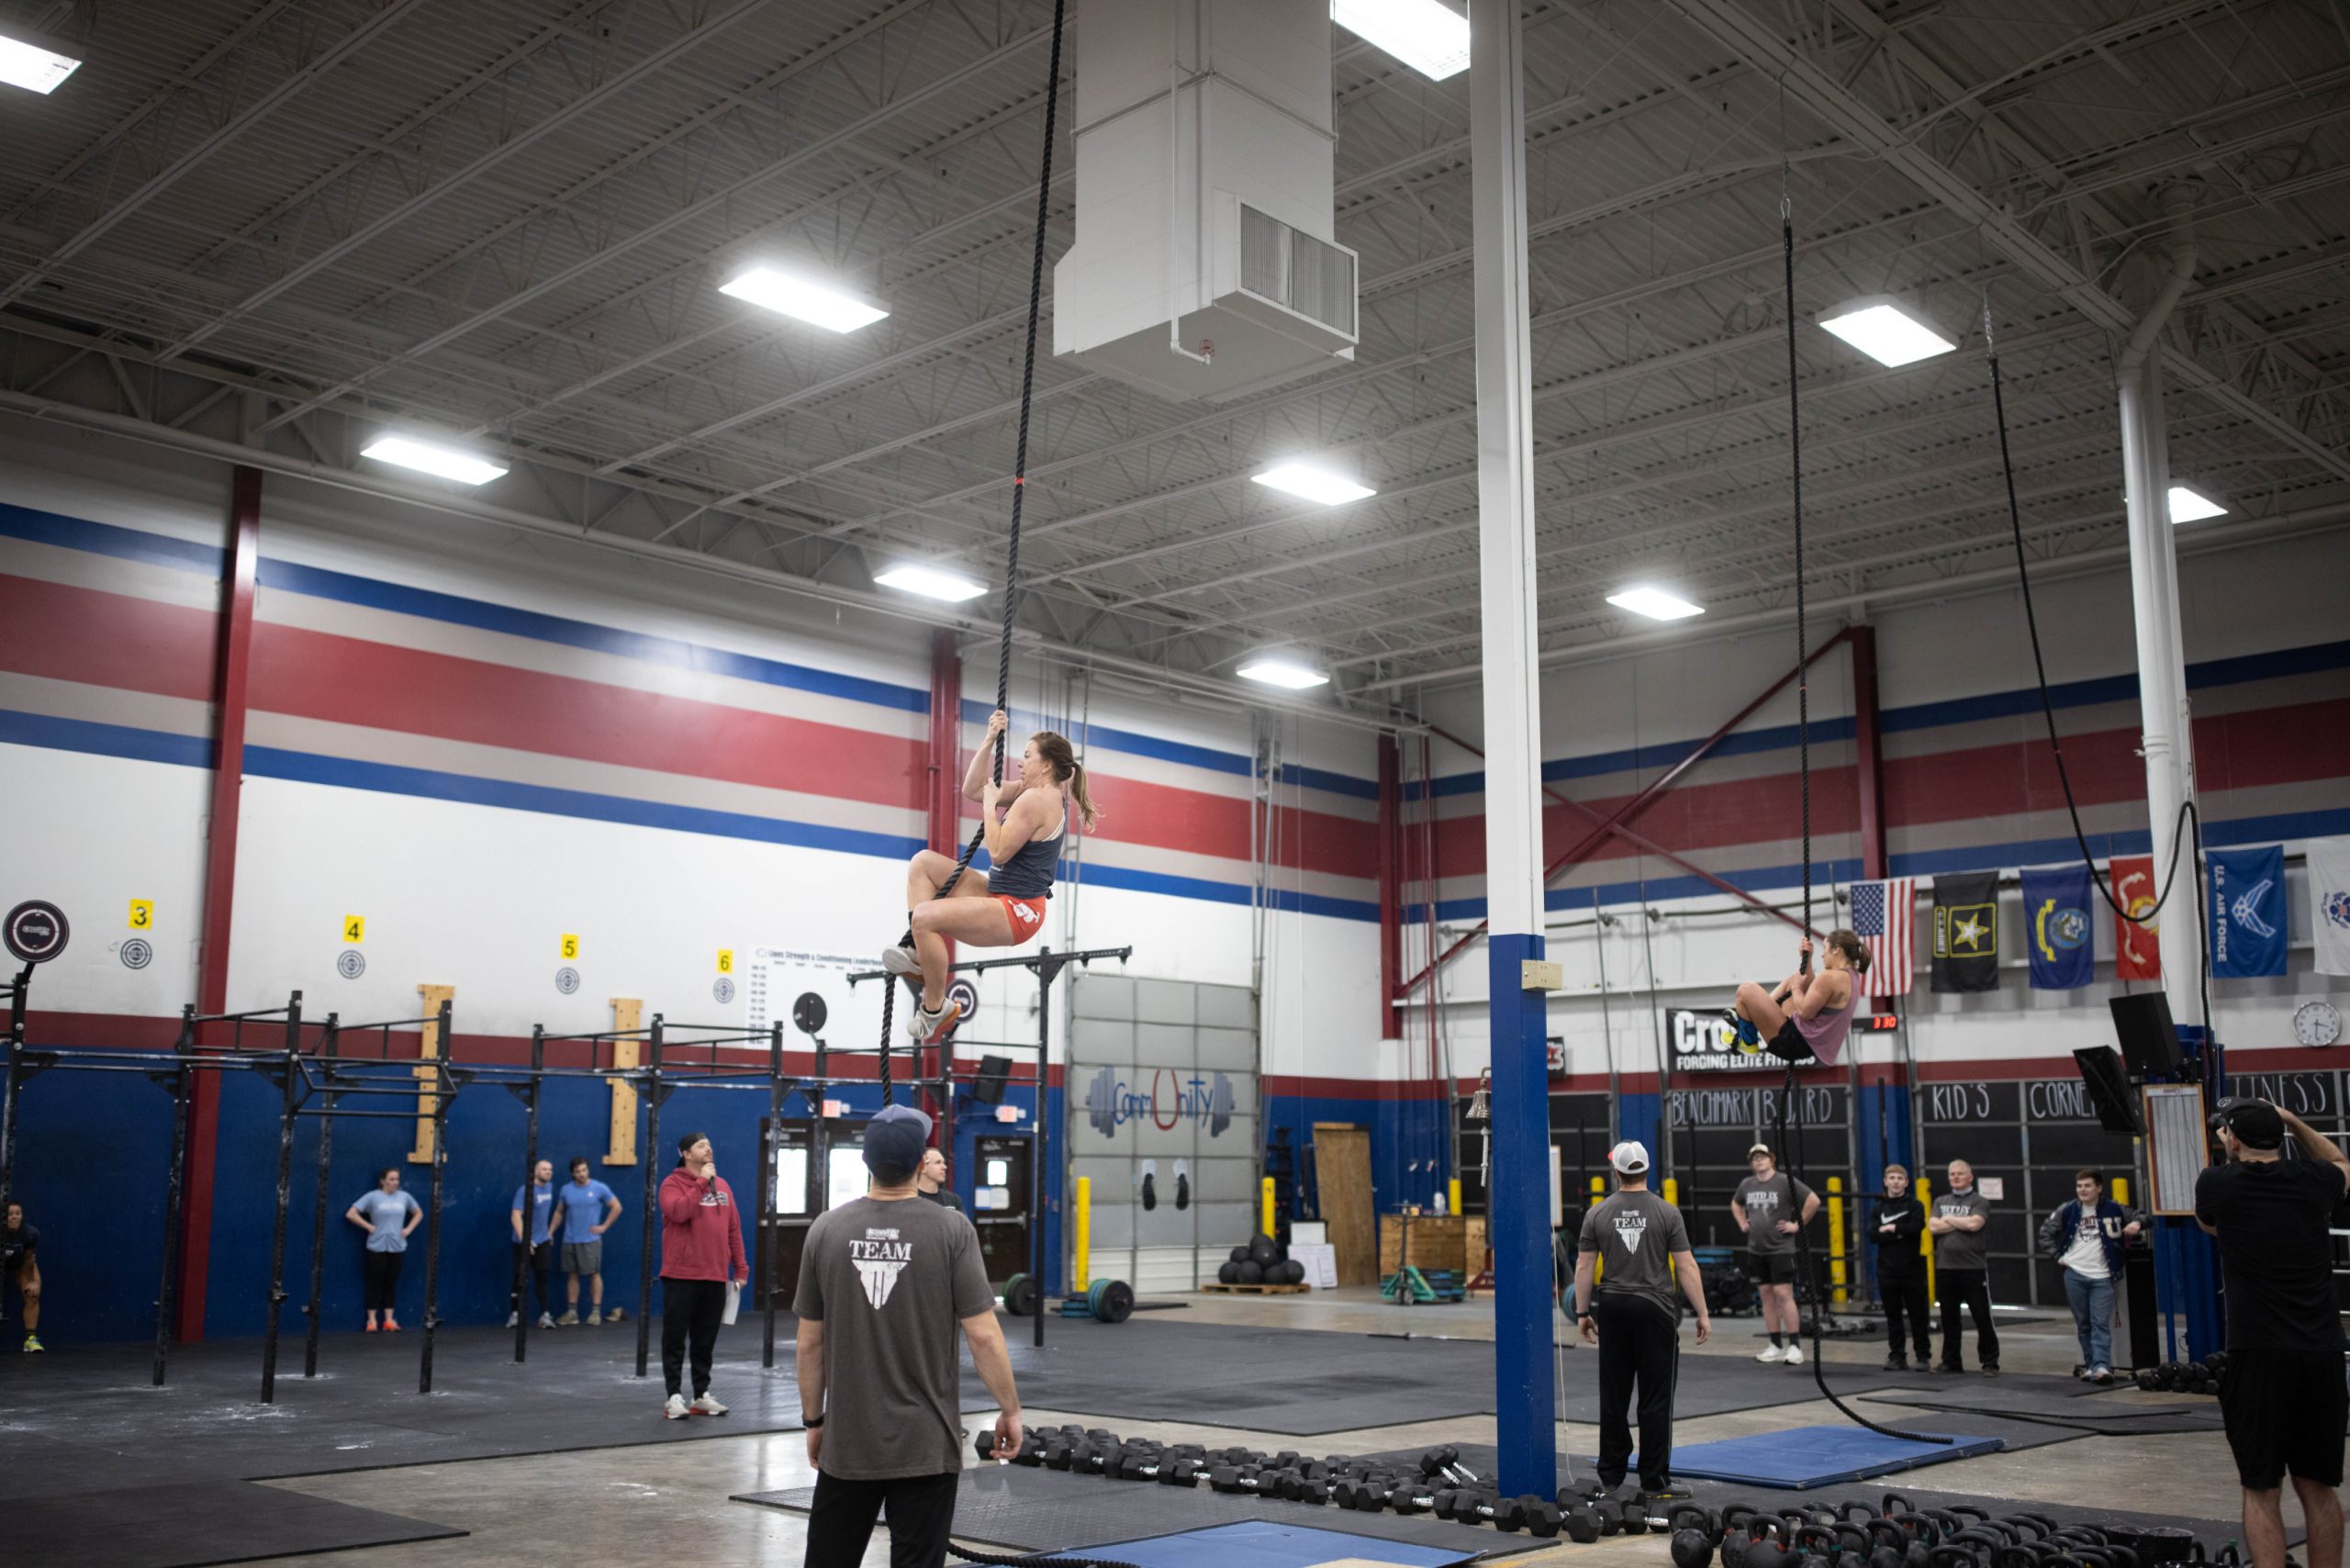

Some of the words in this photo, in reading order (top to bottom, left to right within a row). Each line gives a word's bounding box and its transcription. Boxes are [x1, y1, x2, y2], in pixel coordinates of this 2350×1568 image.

[2214, 865, 2225, 890] U.S.
[2216, 891, 2226, 916] AIR
[134, 906, 147, 925] 3
[347, 922, 360, 940] 4
[2217, 918, 2227, 962] FORCE
[565, 940, 575, 957] 5
[721, 955, 729, 970] 6
[1677, 1055, 1729, 1070] FORGING
[1730, 1053, 1763, 1069] ELITE
[1673, 1090, 1753, 1126] BENCHMARK
[1932, 1082, 1990, 1120] KID'S
[2030, 1081, 2096, 1119] CORNE
[1613, 1217, 1647, 1228] TEAM
[2102, 1216, 2122, 1238] U
[848, 1239, 912, 1261] TEAM
